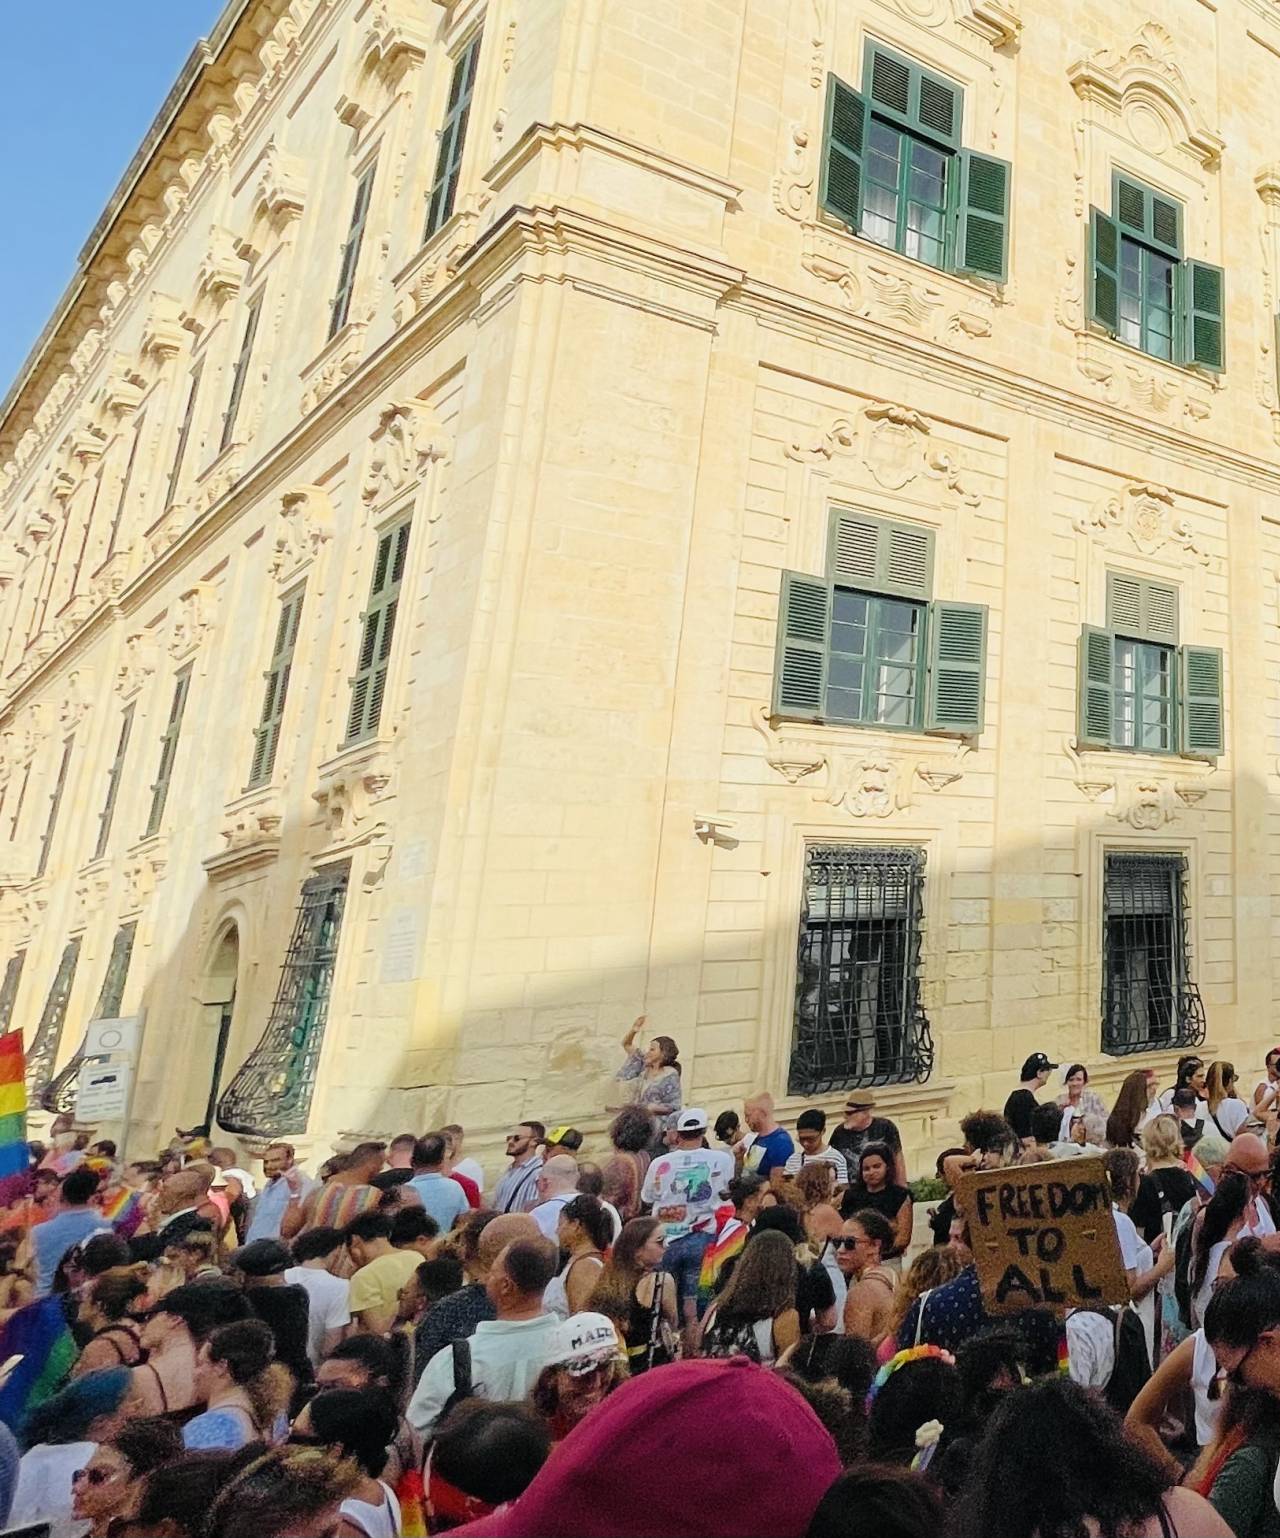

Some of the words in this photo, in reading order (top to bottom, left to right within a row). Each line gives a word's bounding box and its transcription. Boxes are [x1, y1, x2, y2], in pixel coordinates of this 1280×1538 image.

[976, 1182, 1111, 1226] FREEDOM
[1006, 1227, 1067, 1263] TO
[995, 1263, 1103, 1303] ALL
